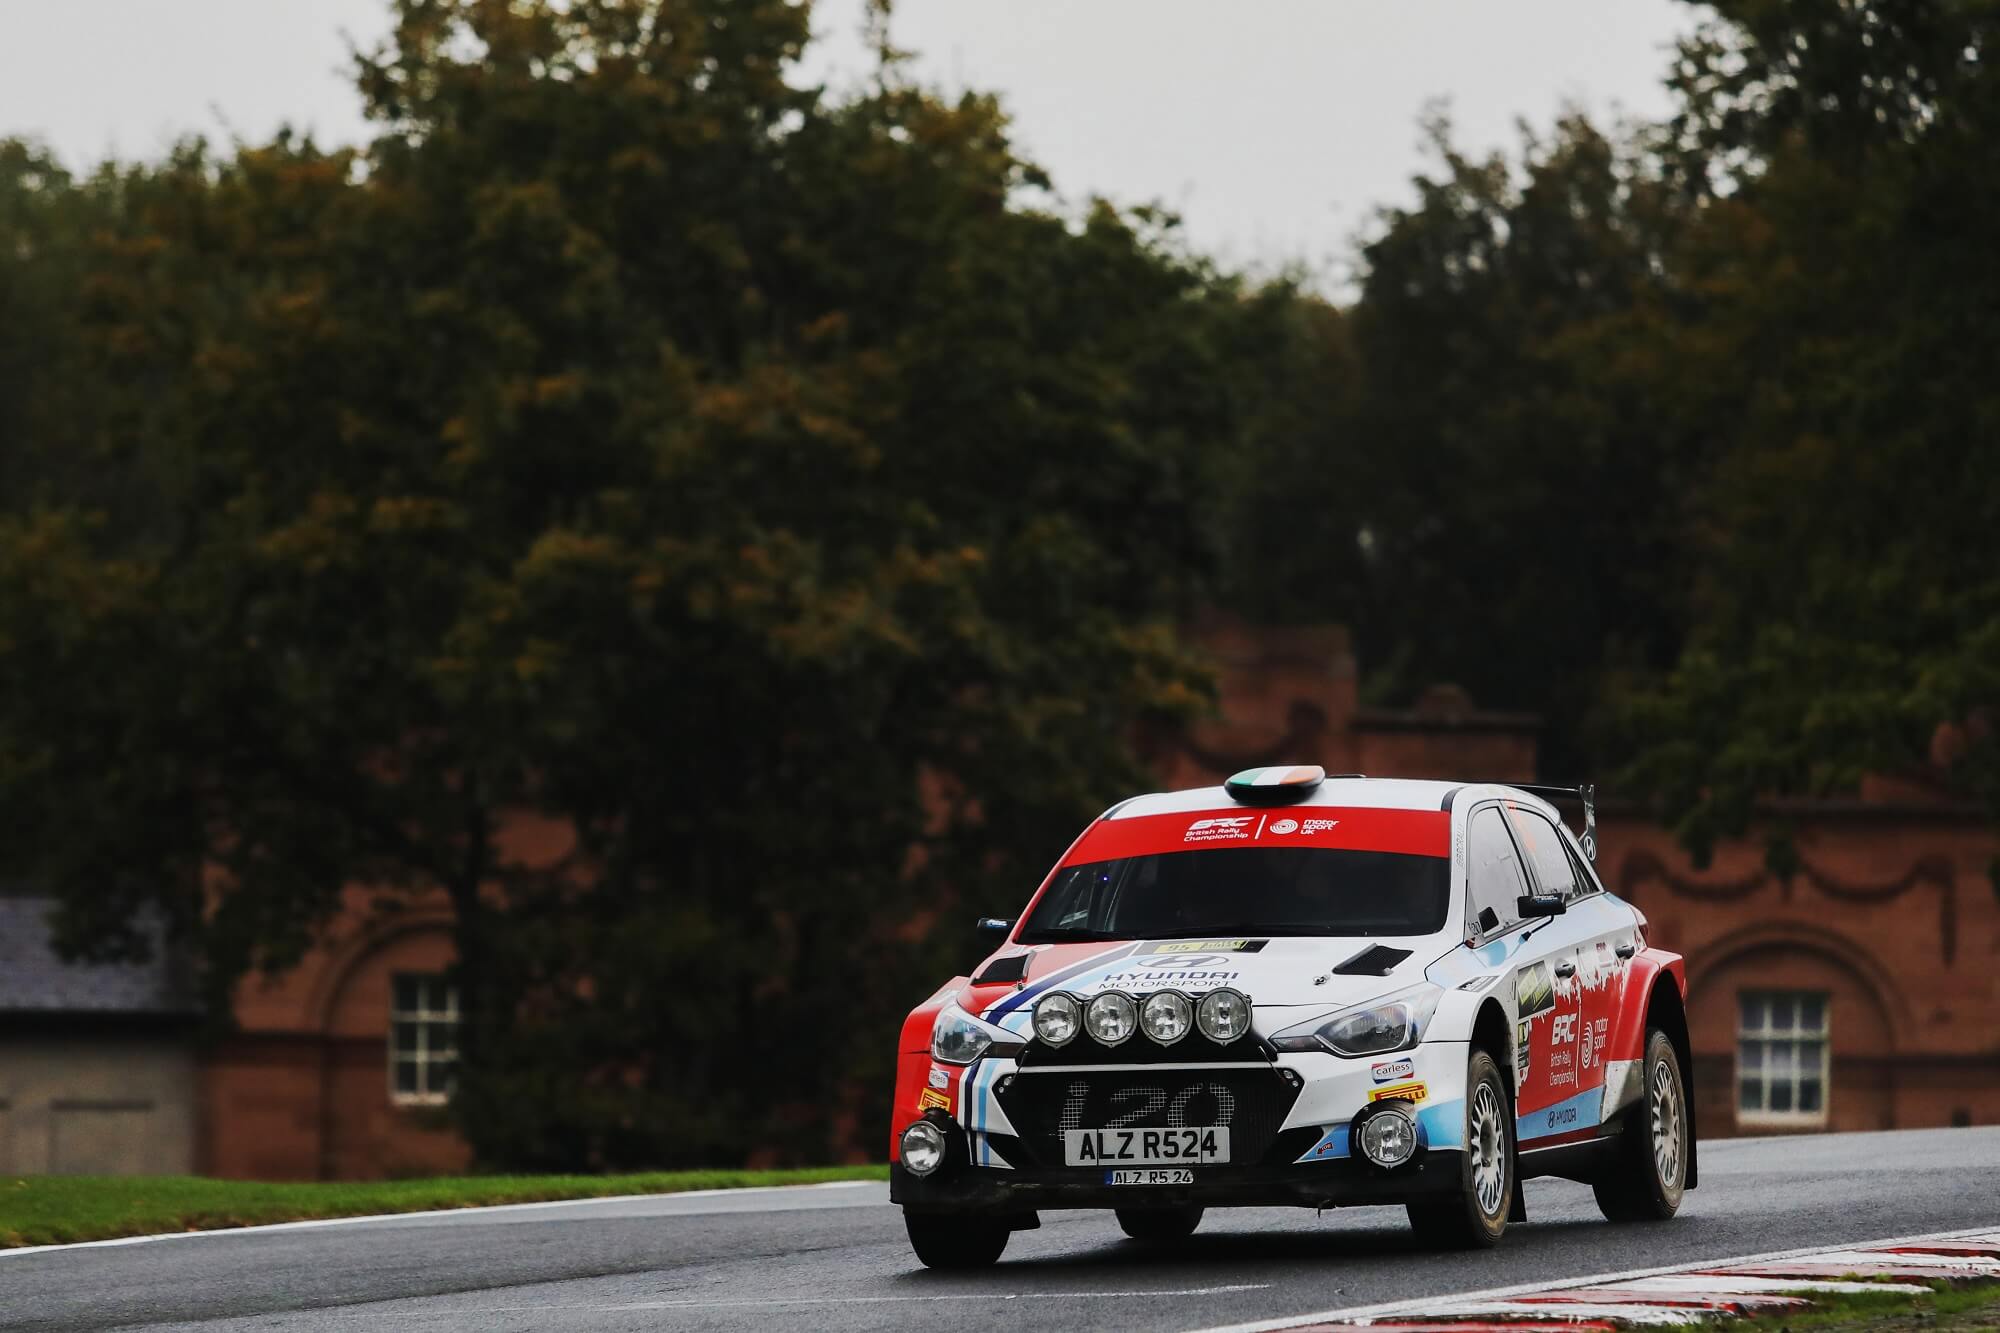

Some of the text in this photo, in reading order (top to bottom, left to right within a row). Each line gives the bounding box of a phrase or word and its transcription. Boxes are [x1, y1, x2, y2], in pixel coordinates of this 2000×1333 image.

[1189, 816, 1254, 830] BRC
[1184, 833, 1249, 842] Championship
[1186, 827, 1240, 837] British Rally
[1103, 971, 1239, 982] HYUNDAI
[1099, 980, 1236, 989] MOTORSPORT
[1552, 1013, 1577, 1046] BRC
[1376, 1063, 1410, 1075] carless
[1079, 1130, 1218, 1160] ALZ R524
[1114, 1171, 1142, 1184] ALZ
